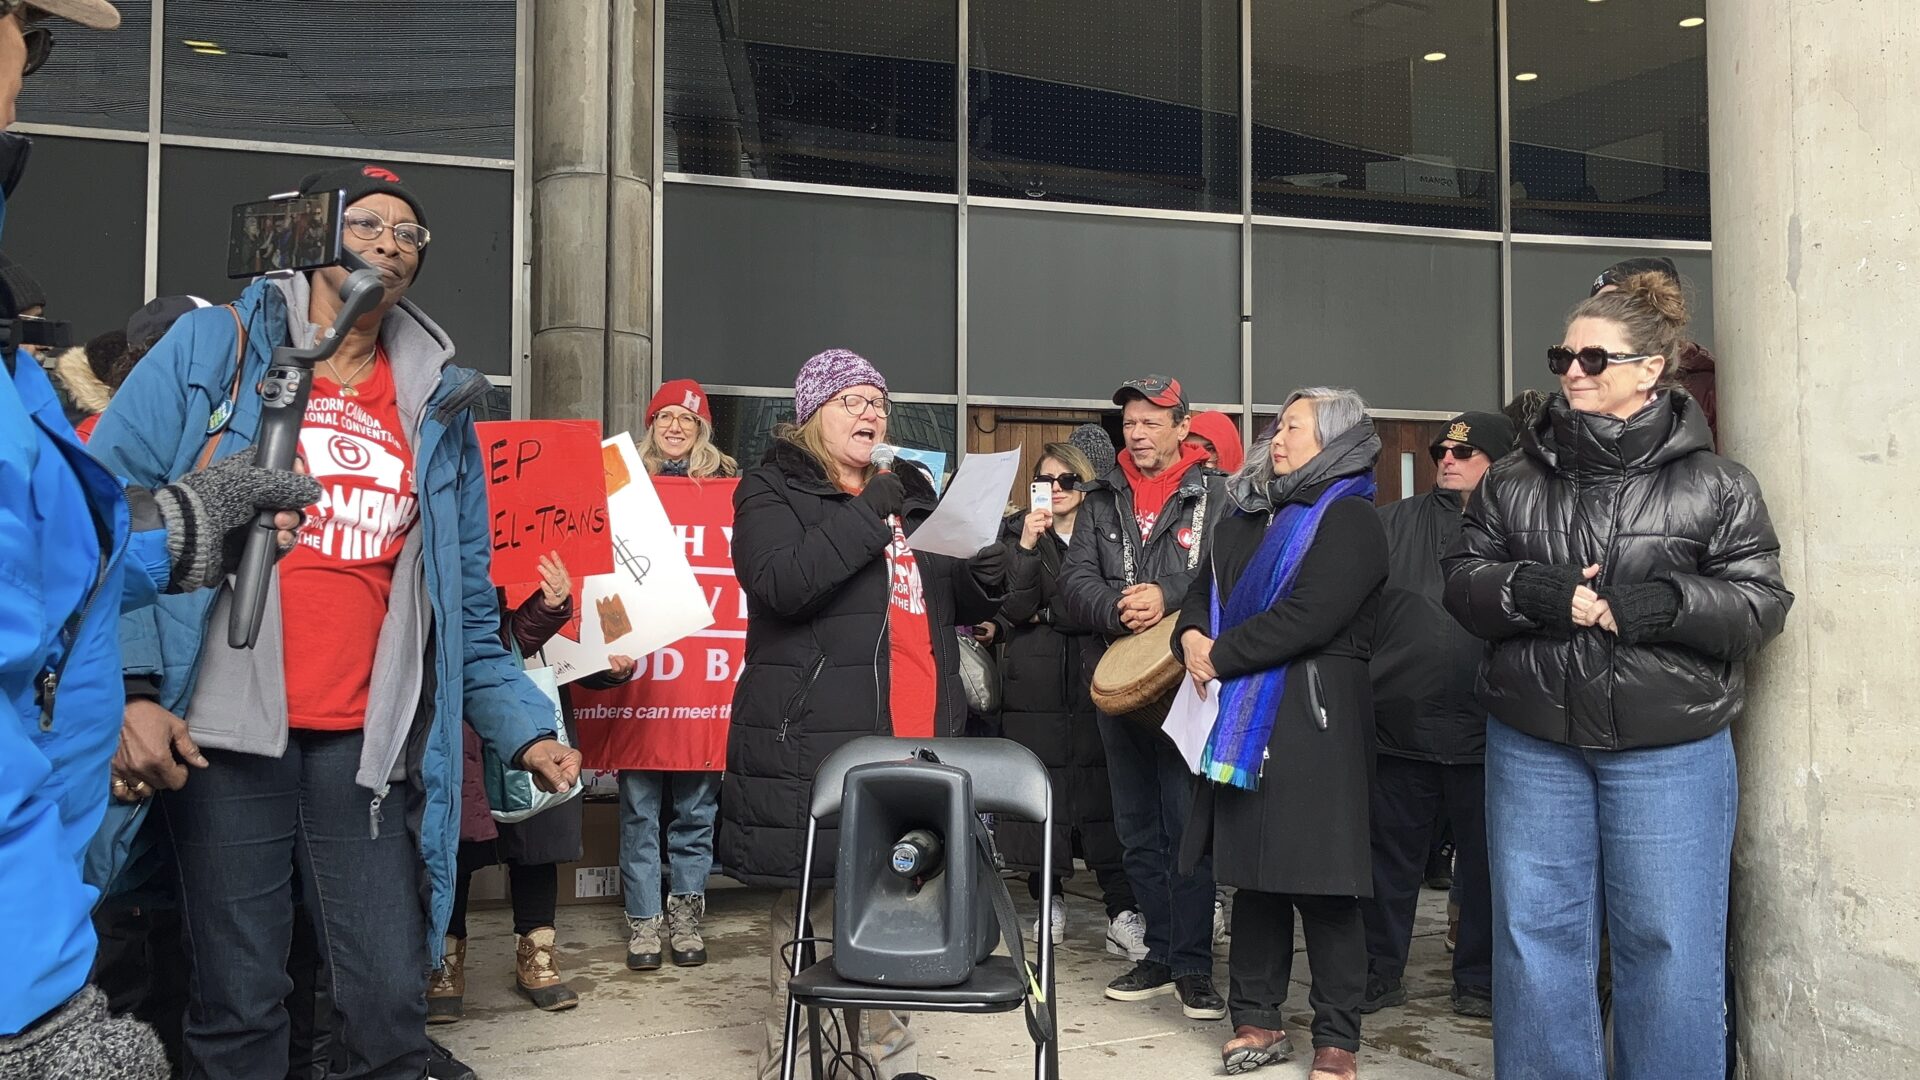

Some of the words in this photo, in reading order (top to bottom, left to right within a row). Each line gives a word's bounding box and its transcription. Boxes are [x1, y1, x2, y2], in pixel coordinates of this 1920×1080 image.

[304, 412, 338, 426] IONAL
[306, 398, 344, 412] ACORN
[345, 402, 382, 430] CANADA
[490, 438, 542, 485] EP
[305, 514, 327, 531] FOR
[493, 505, 606, 551] EL-TRANS
[894, 582, 909, 595] FOR
[894, 596, 909, 610] THE
[573, 703, 634, 720] embers
[638, 707, 669, 719] can
[672, 706, 717, 719] meet
